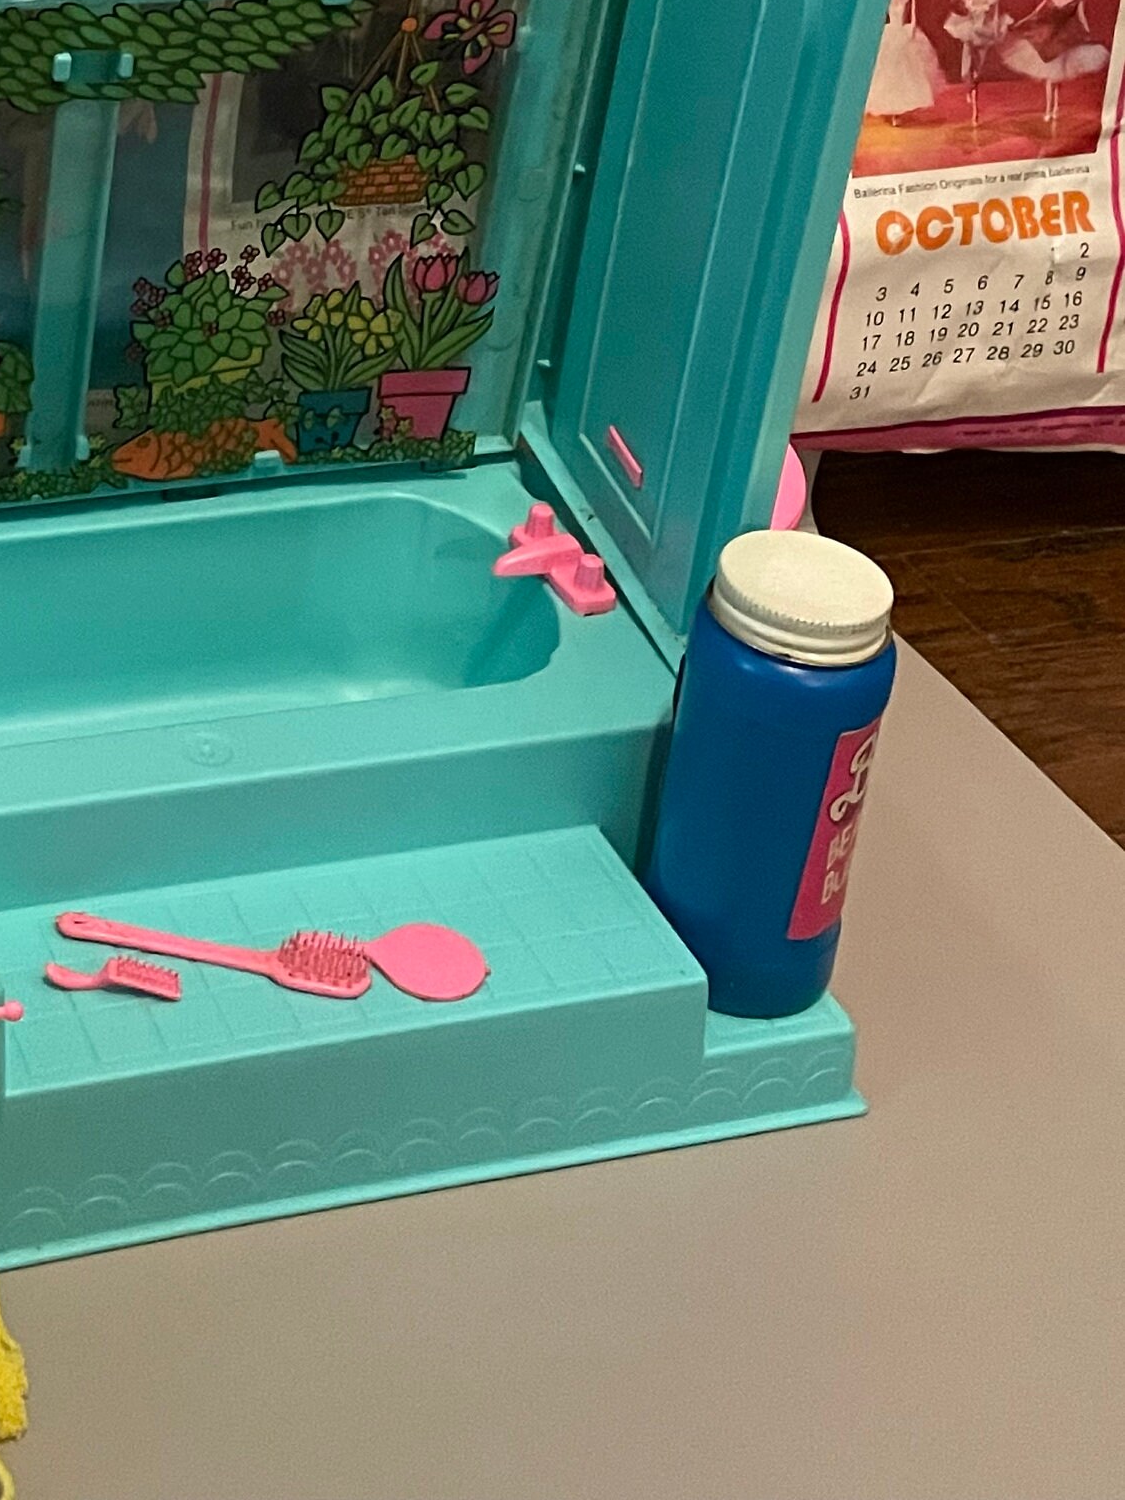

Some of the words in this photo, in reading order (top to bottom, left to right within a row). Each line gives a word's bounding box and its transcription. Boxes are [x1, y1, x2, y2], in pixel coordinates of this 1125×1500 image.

[875, 191, 1095, 256] OCTOBER
[856, 360, 877, 378] 24
[888, 355, 911, 373] 25
[921, 350, 944, 368] 26
[952, 347, 976, 364] 27
[985, 345, 1010, 361] 28
[1019, 342, 1044, 359] 29
[1053, 339, 1075, 356] 30
